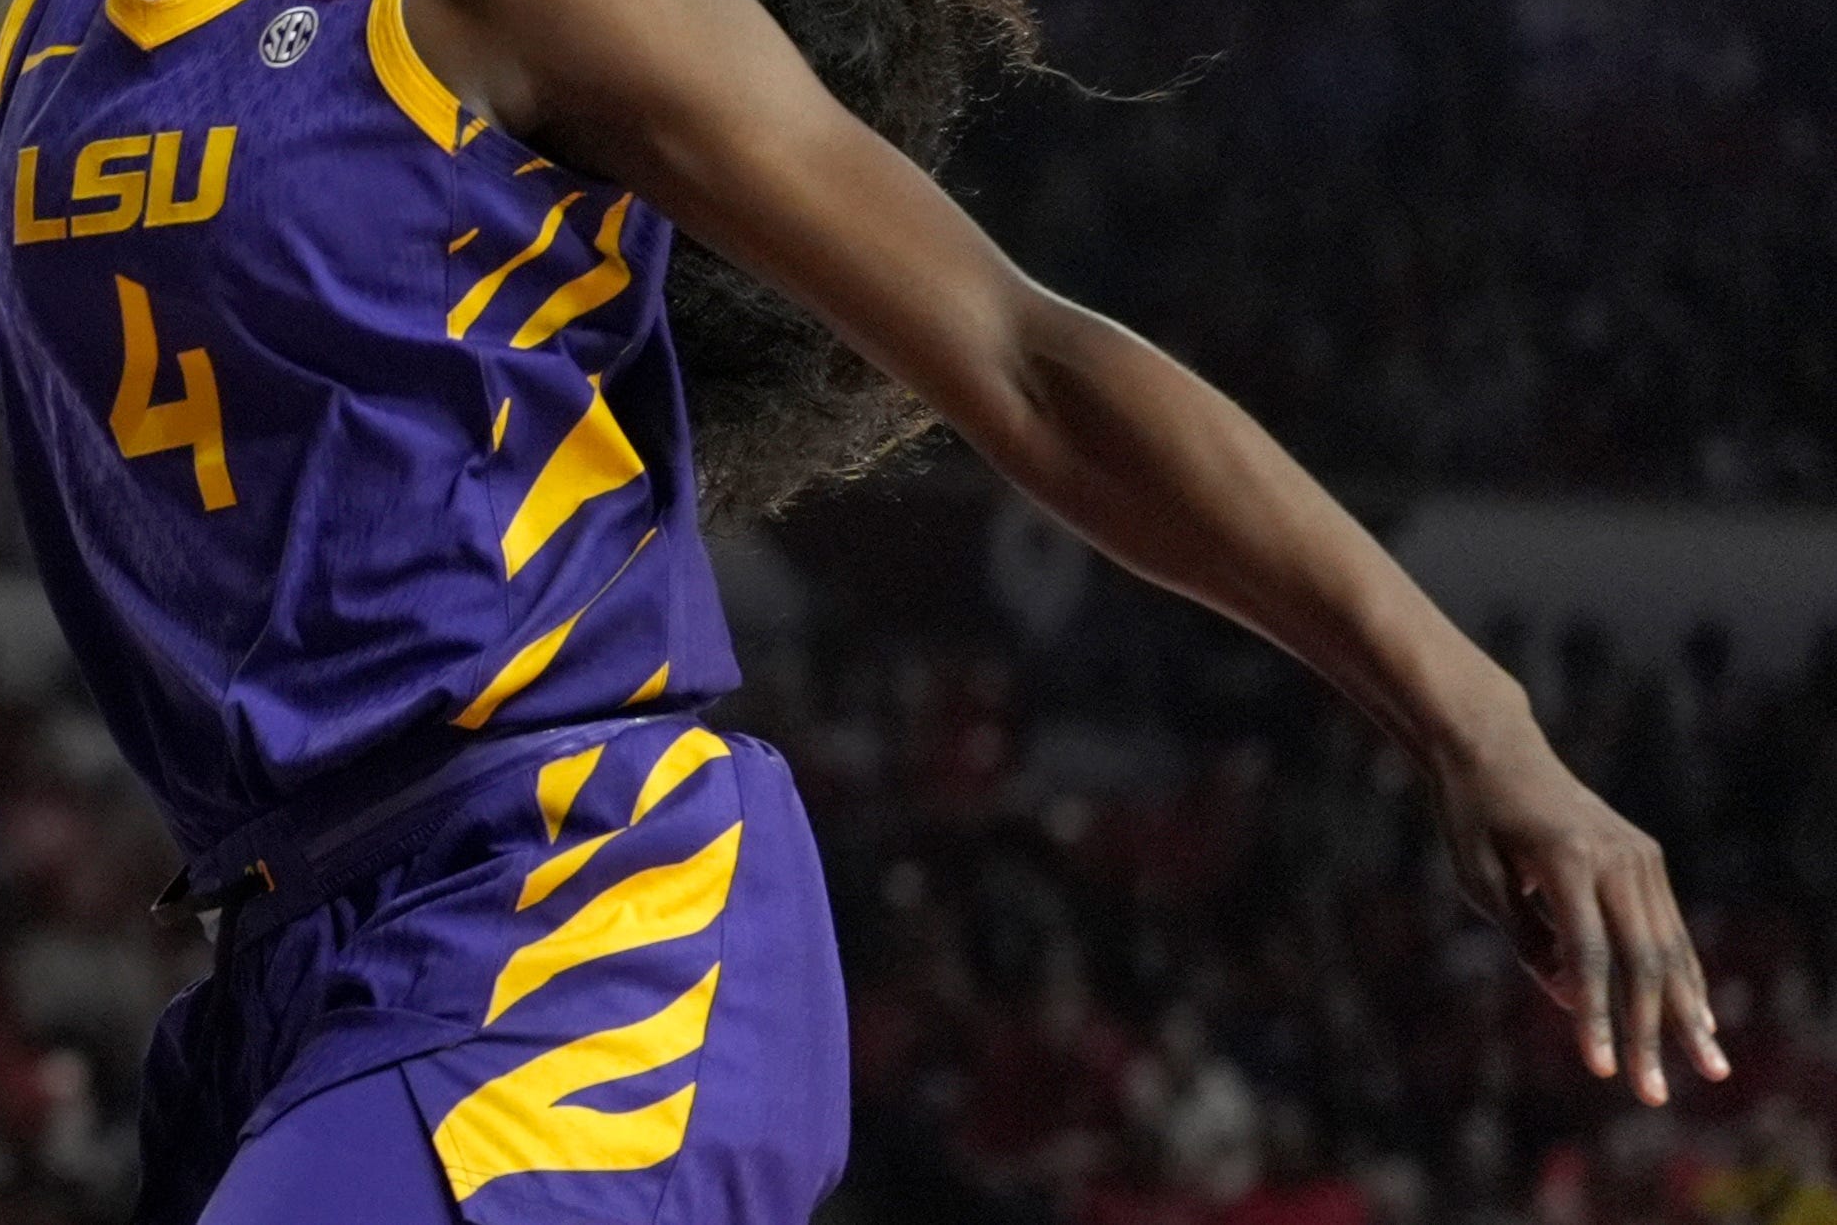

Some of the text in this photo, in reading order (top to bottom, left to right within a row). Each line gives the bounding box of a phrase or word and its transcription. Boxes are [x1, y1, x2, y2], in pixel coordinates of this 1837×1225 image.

[264, 12, 314, 62] SEC
[13, 125, 237, 245] LSU
[108, 274, 237, 511] 4
